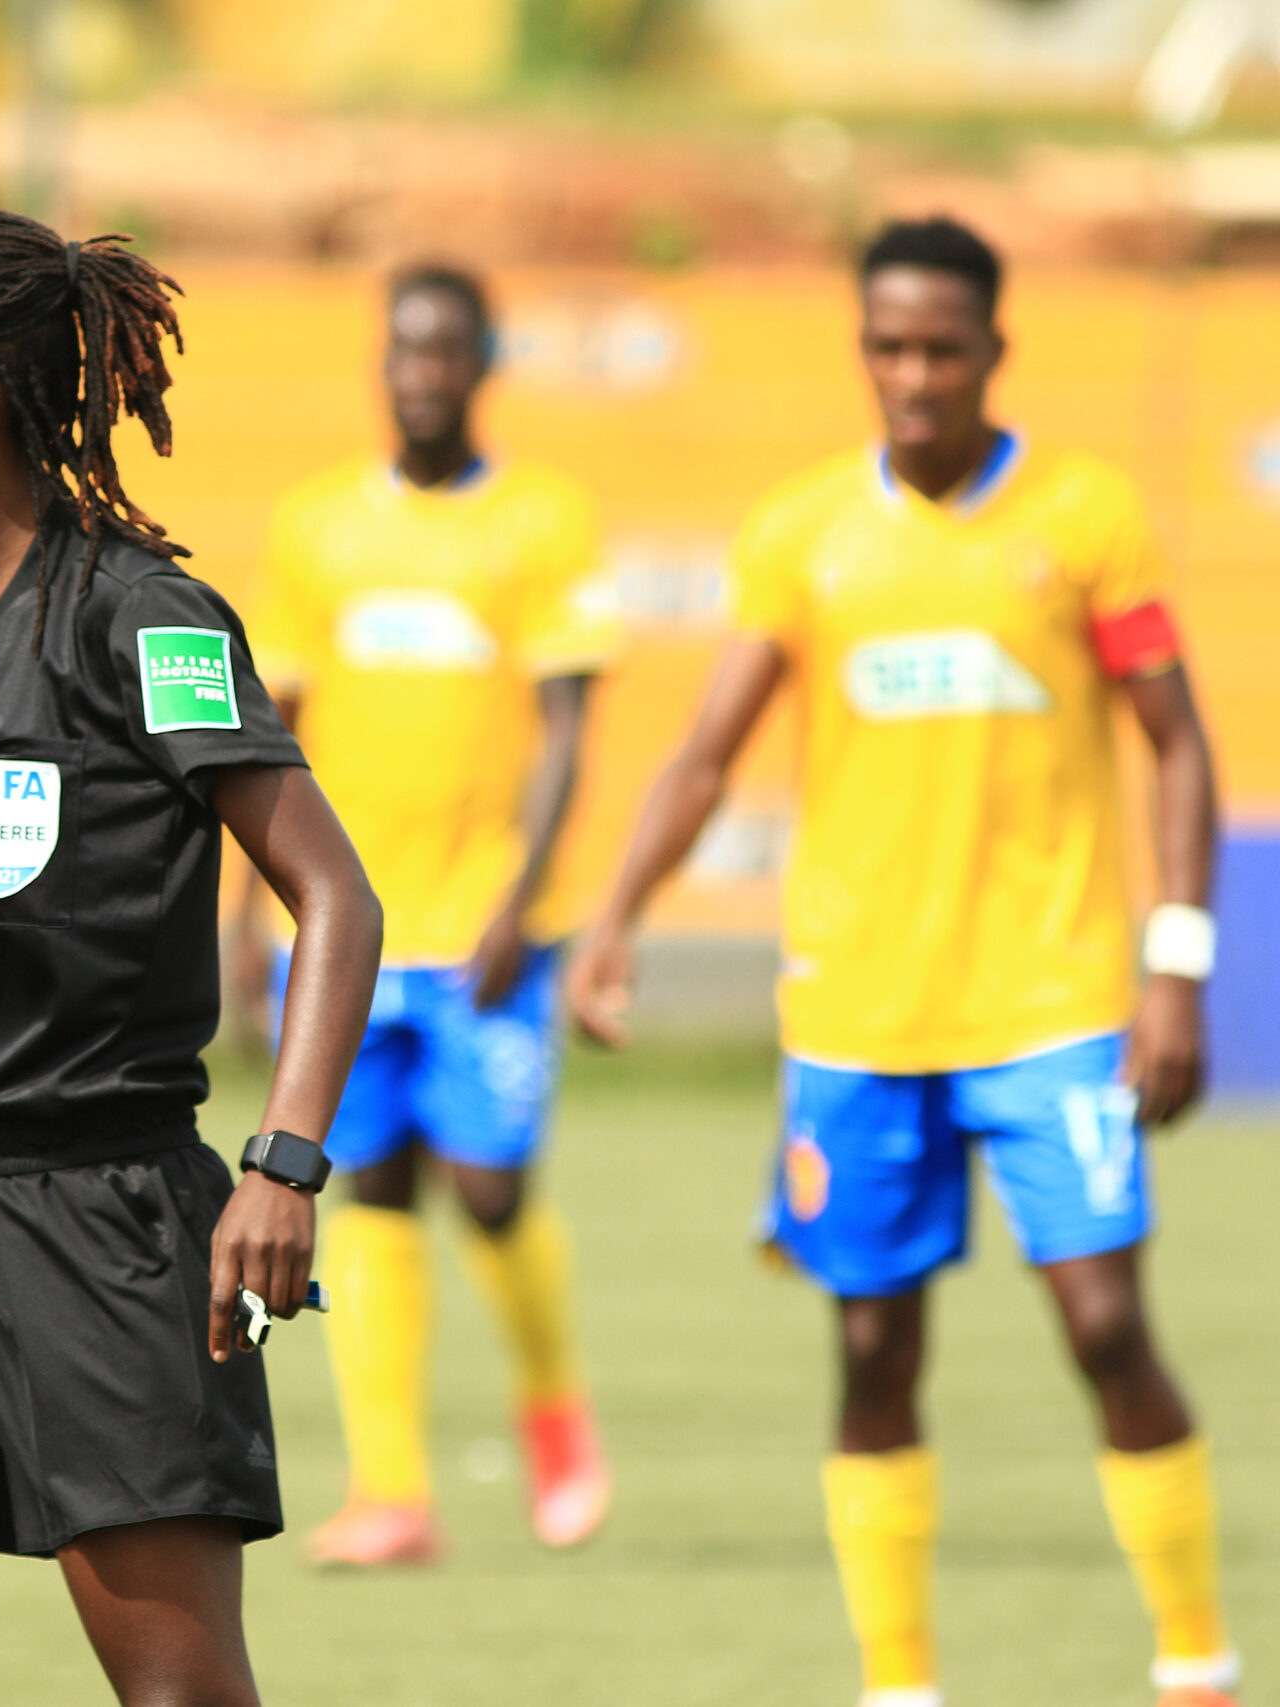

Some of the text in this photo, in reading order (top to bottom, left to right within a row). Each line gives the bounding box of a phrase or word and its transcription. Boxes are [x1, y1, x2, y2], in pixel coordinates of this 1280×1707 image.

[150, 656, 224, 670] LIVING
[151, 666, 225, 680] FOOTBALL
[195, 686, 227, 702] FIFA
